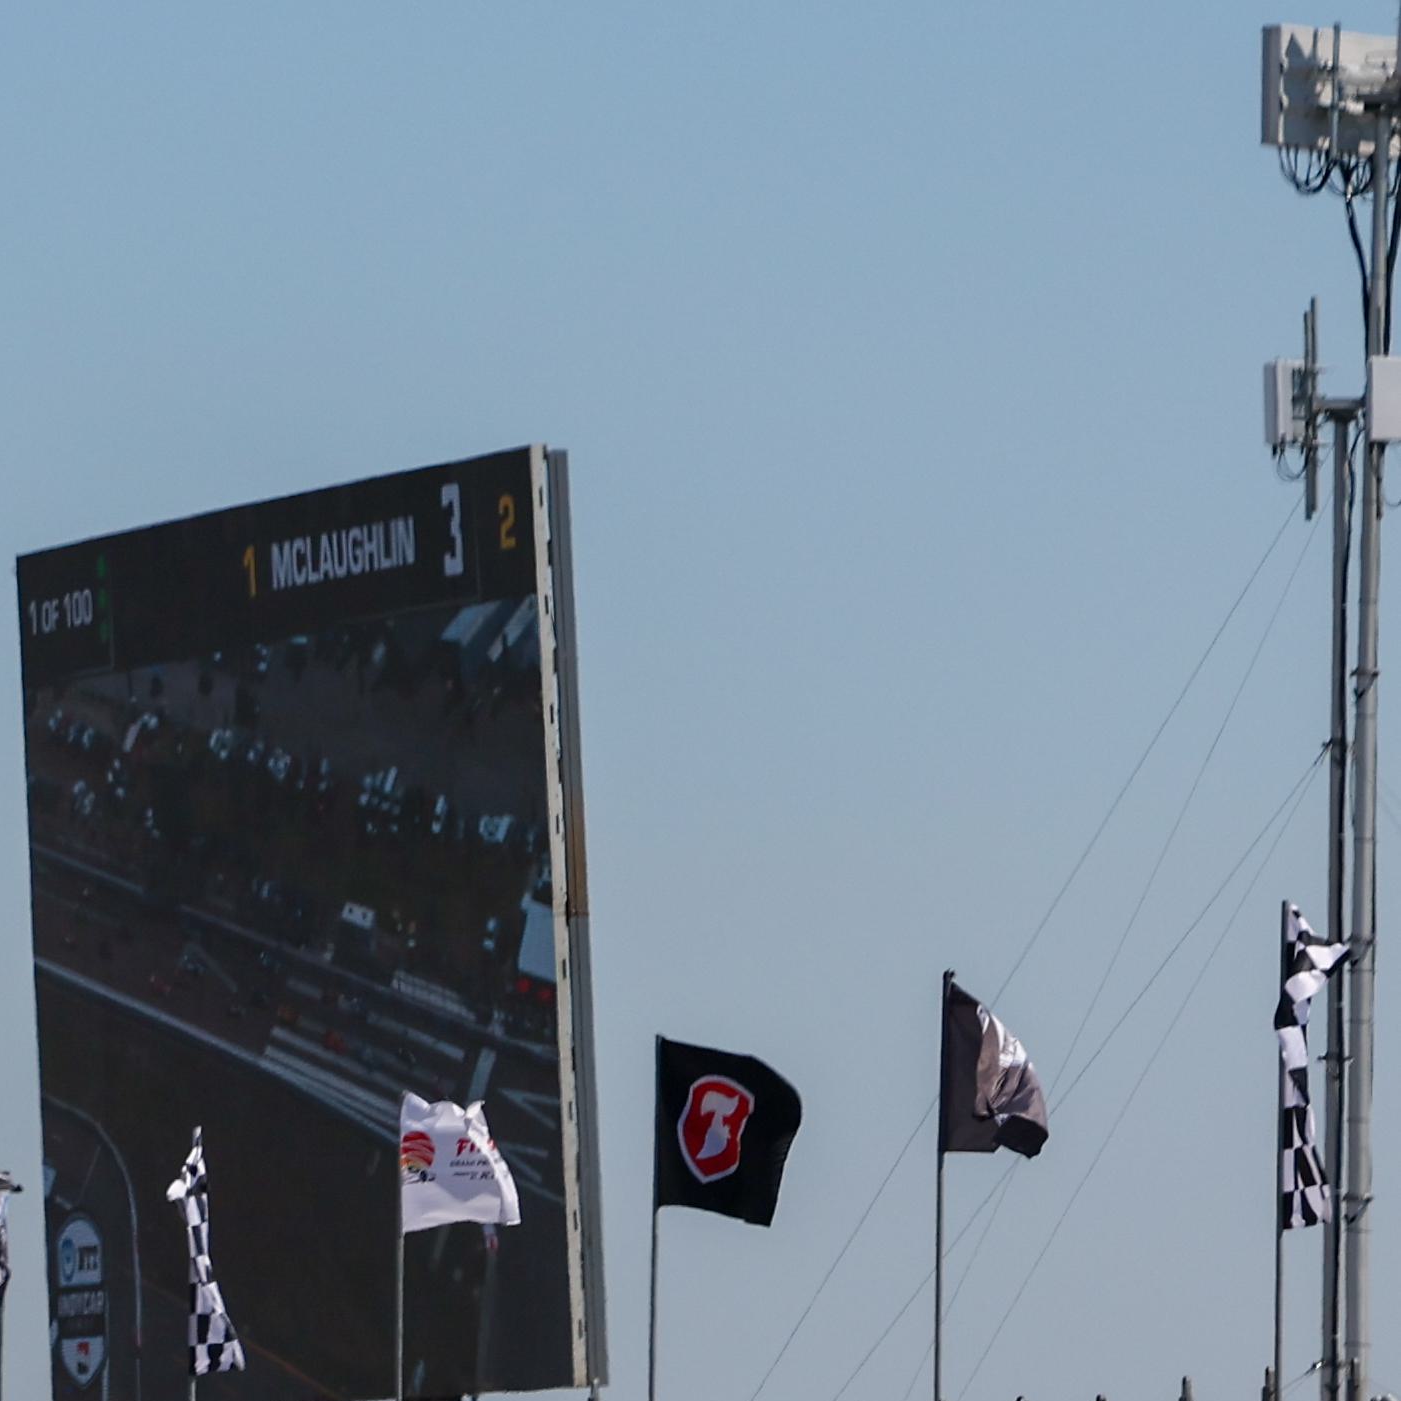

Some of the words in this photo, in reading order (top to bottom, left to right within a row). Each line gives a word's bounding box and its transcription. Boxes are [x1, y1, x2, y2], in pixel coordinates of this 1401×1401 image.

[243, 545, 257, 597] 1
[271, 515, 415, 590] MCLAUGHLIN
[440, 483, 464, 577] 3
[498, 494, 516, 549] 2
[29, 600, 37, 635] 1
[42, 599, 59, 633] OF
[64, 589, 93, 628] 100
